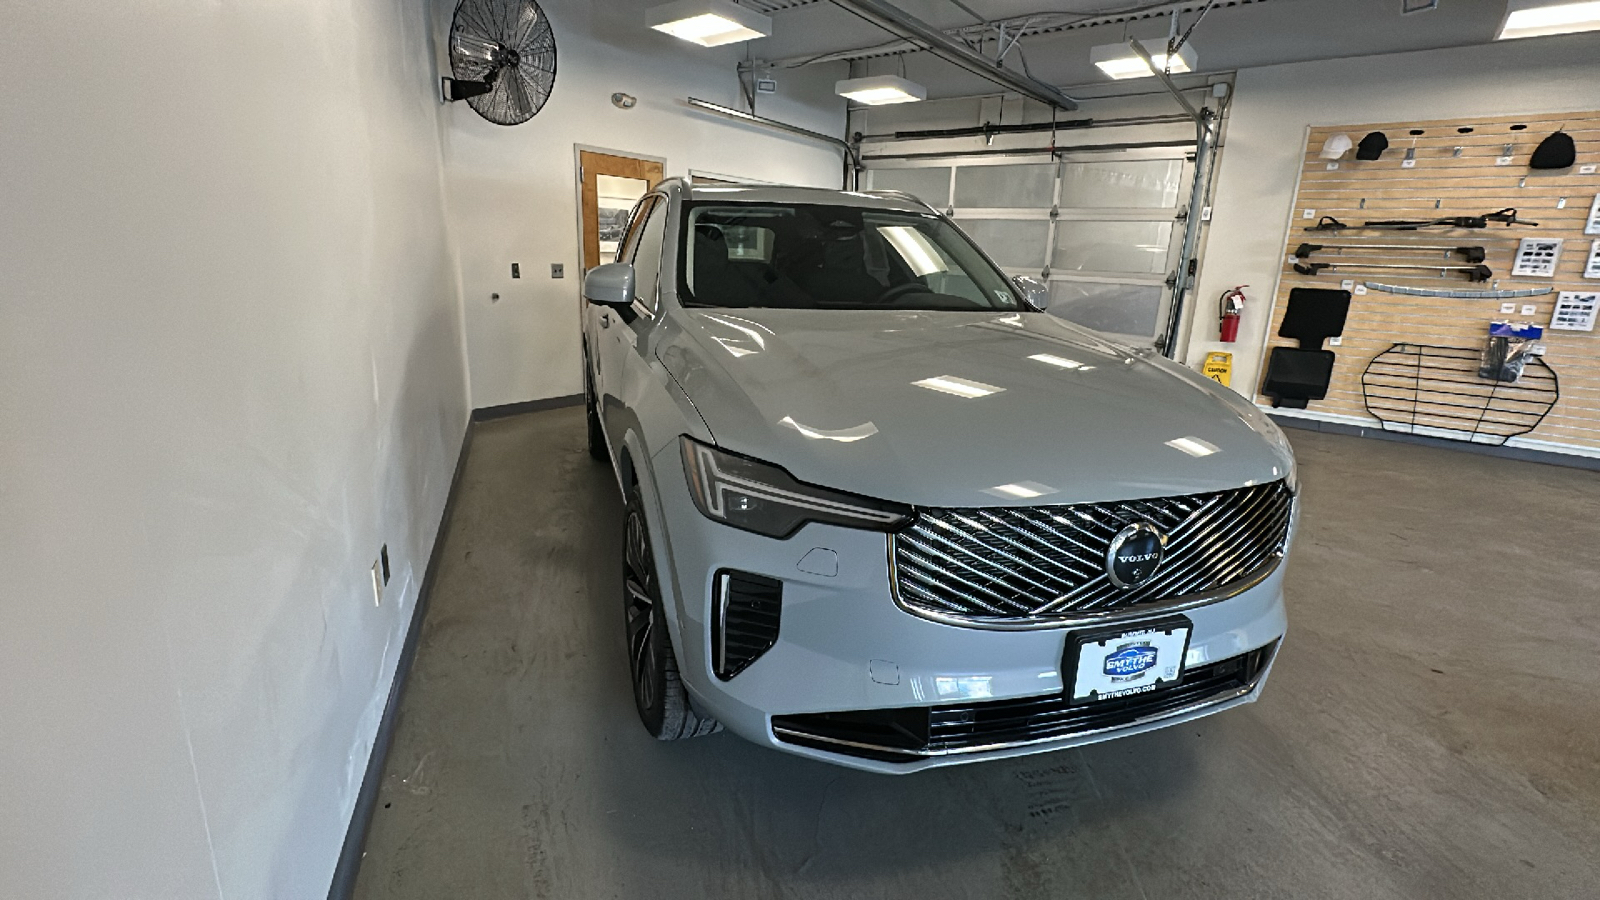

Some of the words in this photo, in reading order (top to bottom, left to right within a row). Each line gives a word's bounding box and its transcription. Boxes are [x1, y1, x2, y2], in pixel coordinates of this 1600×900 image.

[1207, 366, 1228, 374] CAUTION
[1118, 553, 1158, 563] VOLVO
[1106, 655, 1154, 670] SMYTHE
[1116, 663, 1146, 673] VOLVO
[1098, 685, 1156, 701] SMYTHEVOLVO.COM
